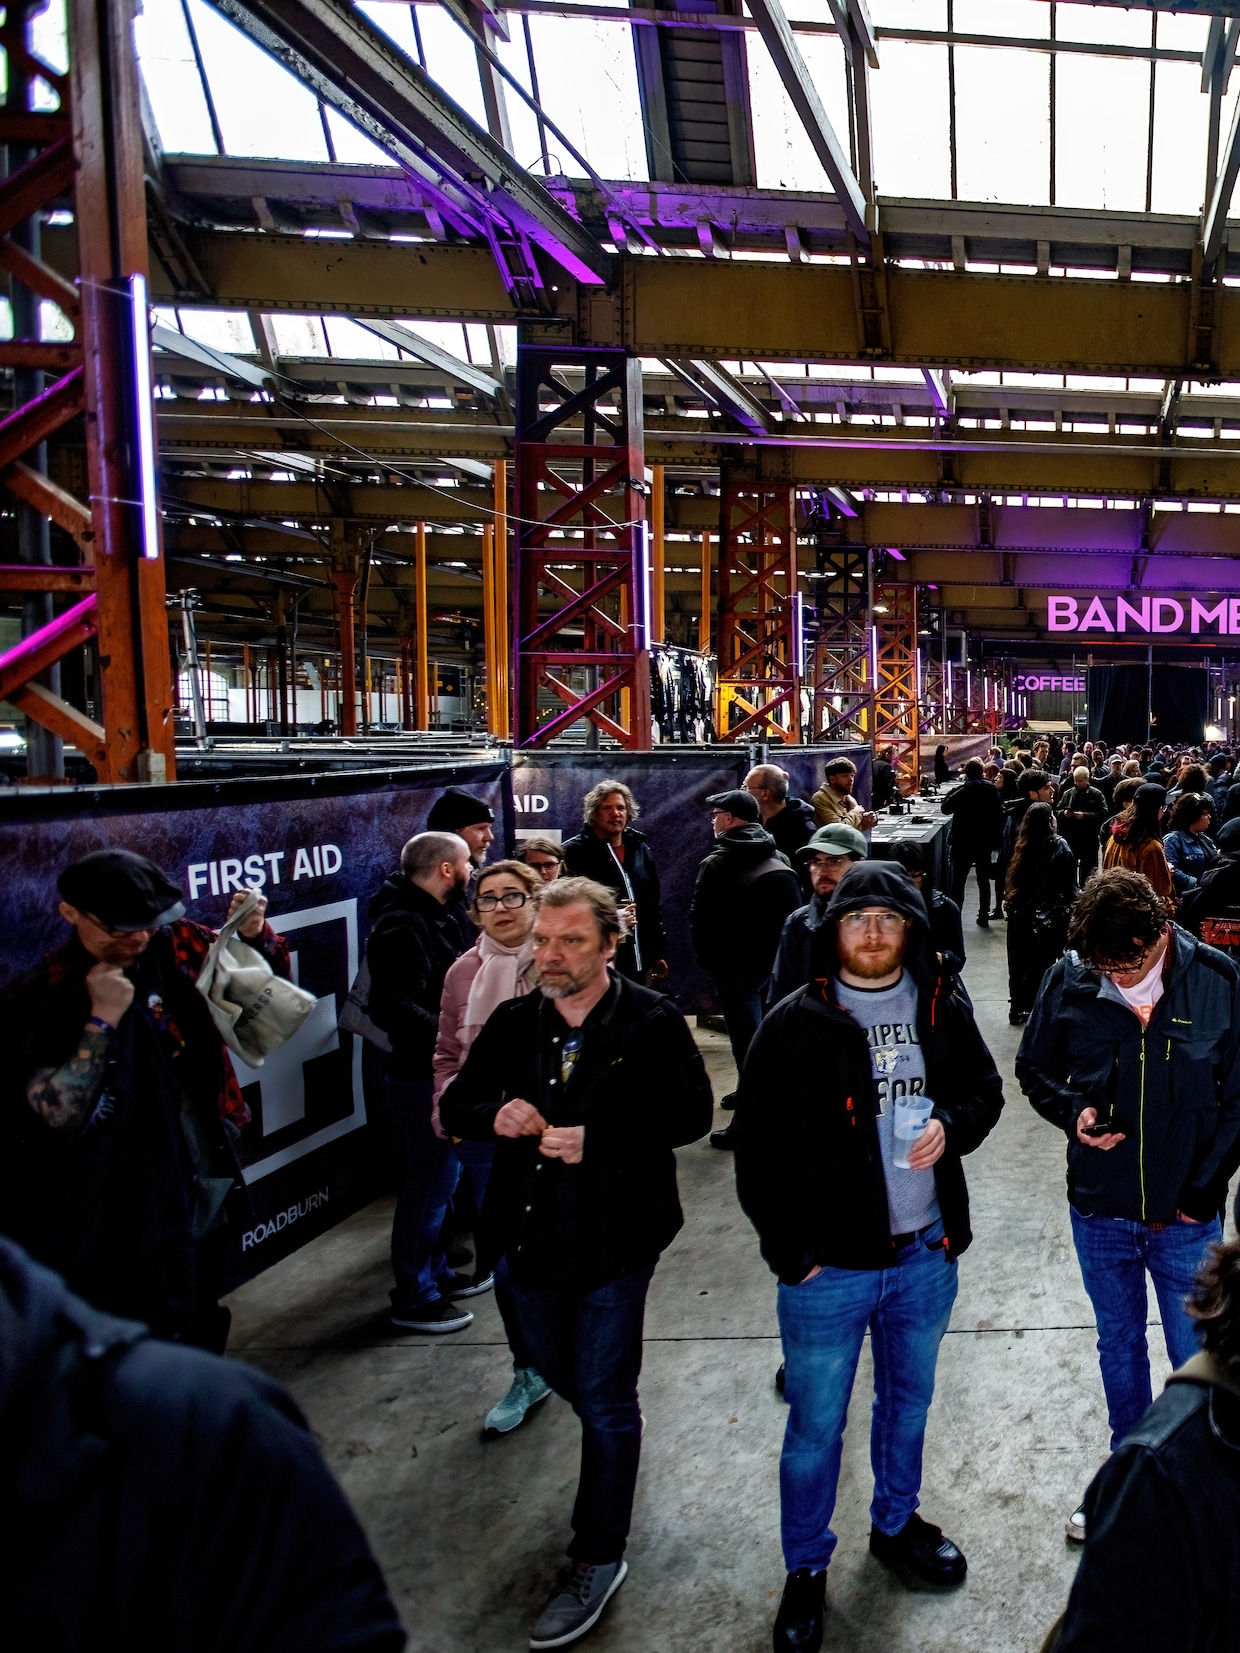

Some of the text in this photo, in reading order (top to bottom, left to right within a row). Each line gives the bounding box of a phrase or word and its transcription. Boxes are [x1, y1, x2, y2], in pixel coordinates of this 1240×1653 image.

[1047, 595, 1185, 633] BAND
[1012, 675, 1086, 692] COFFEE
[513, 794, 549, 813] AID
[187, 844, 343, 900] FIRST AID
[242, 1186, 329, 1252] ROADBURN
